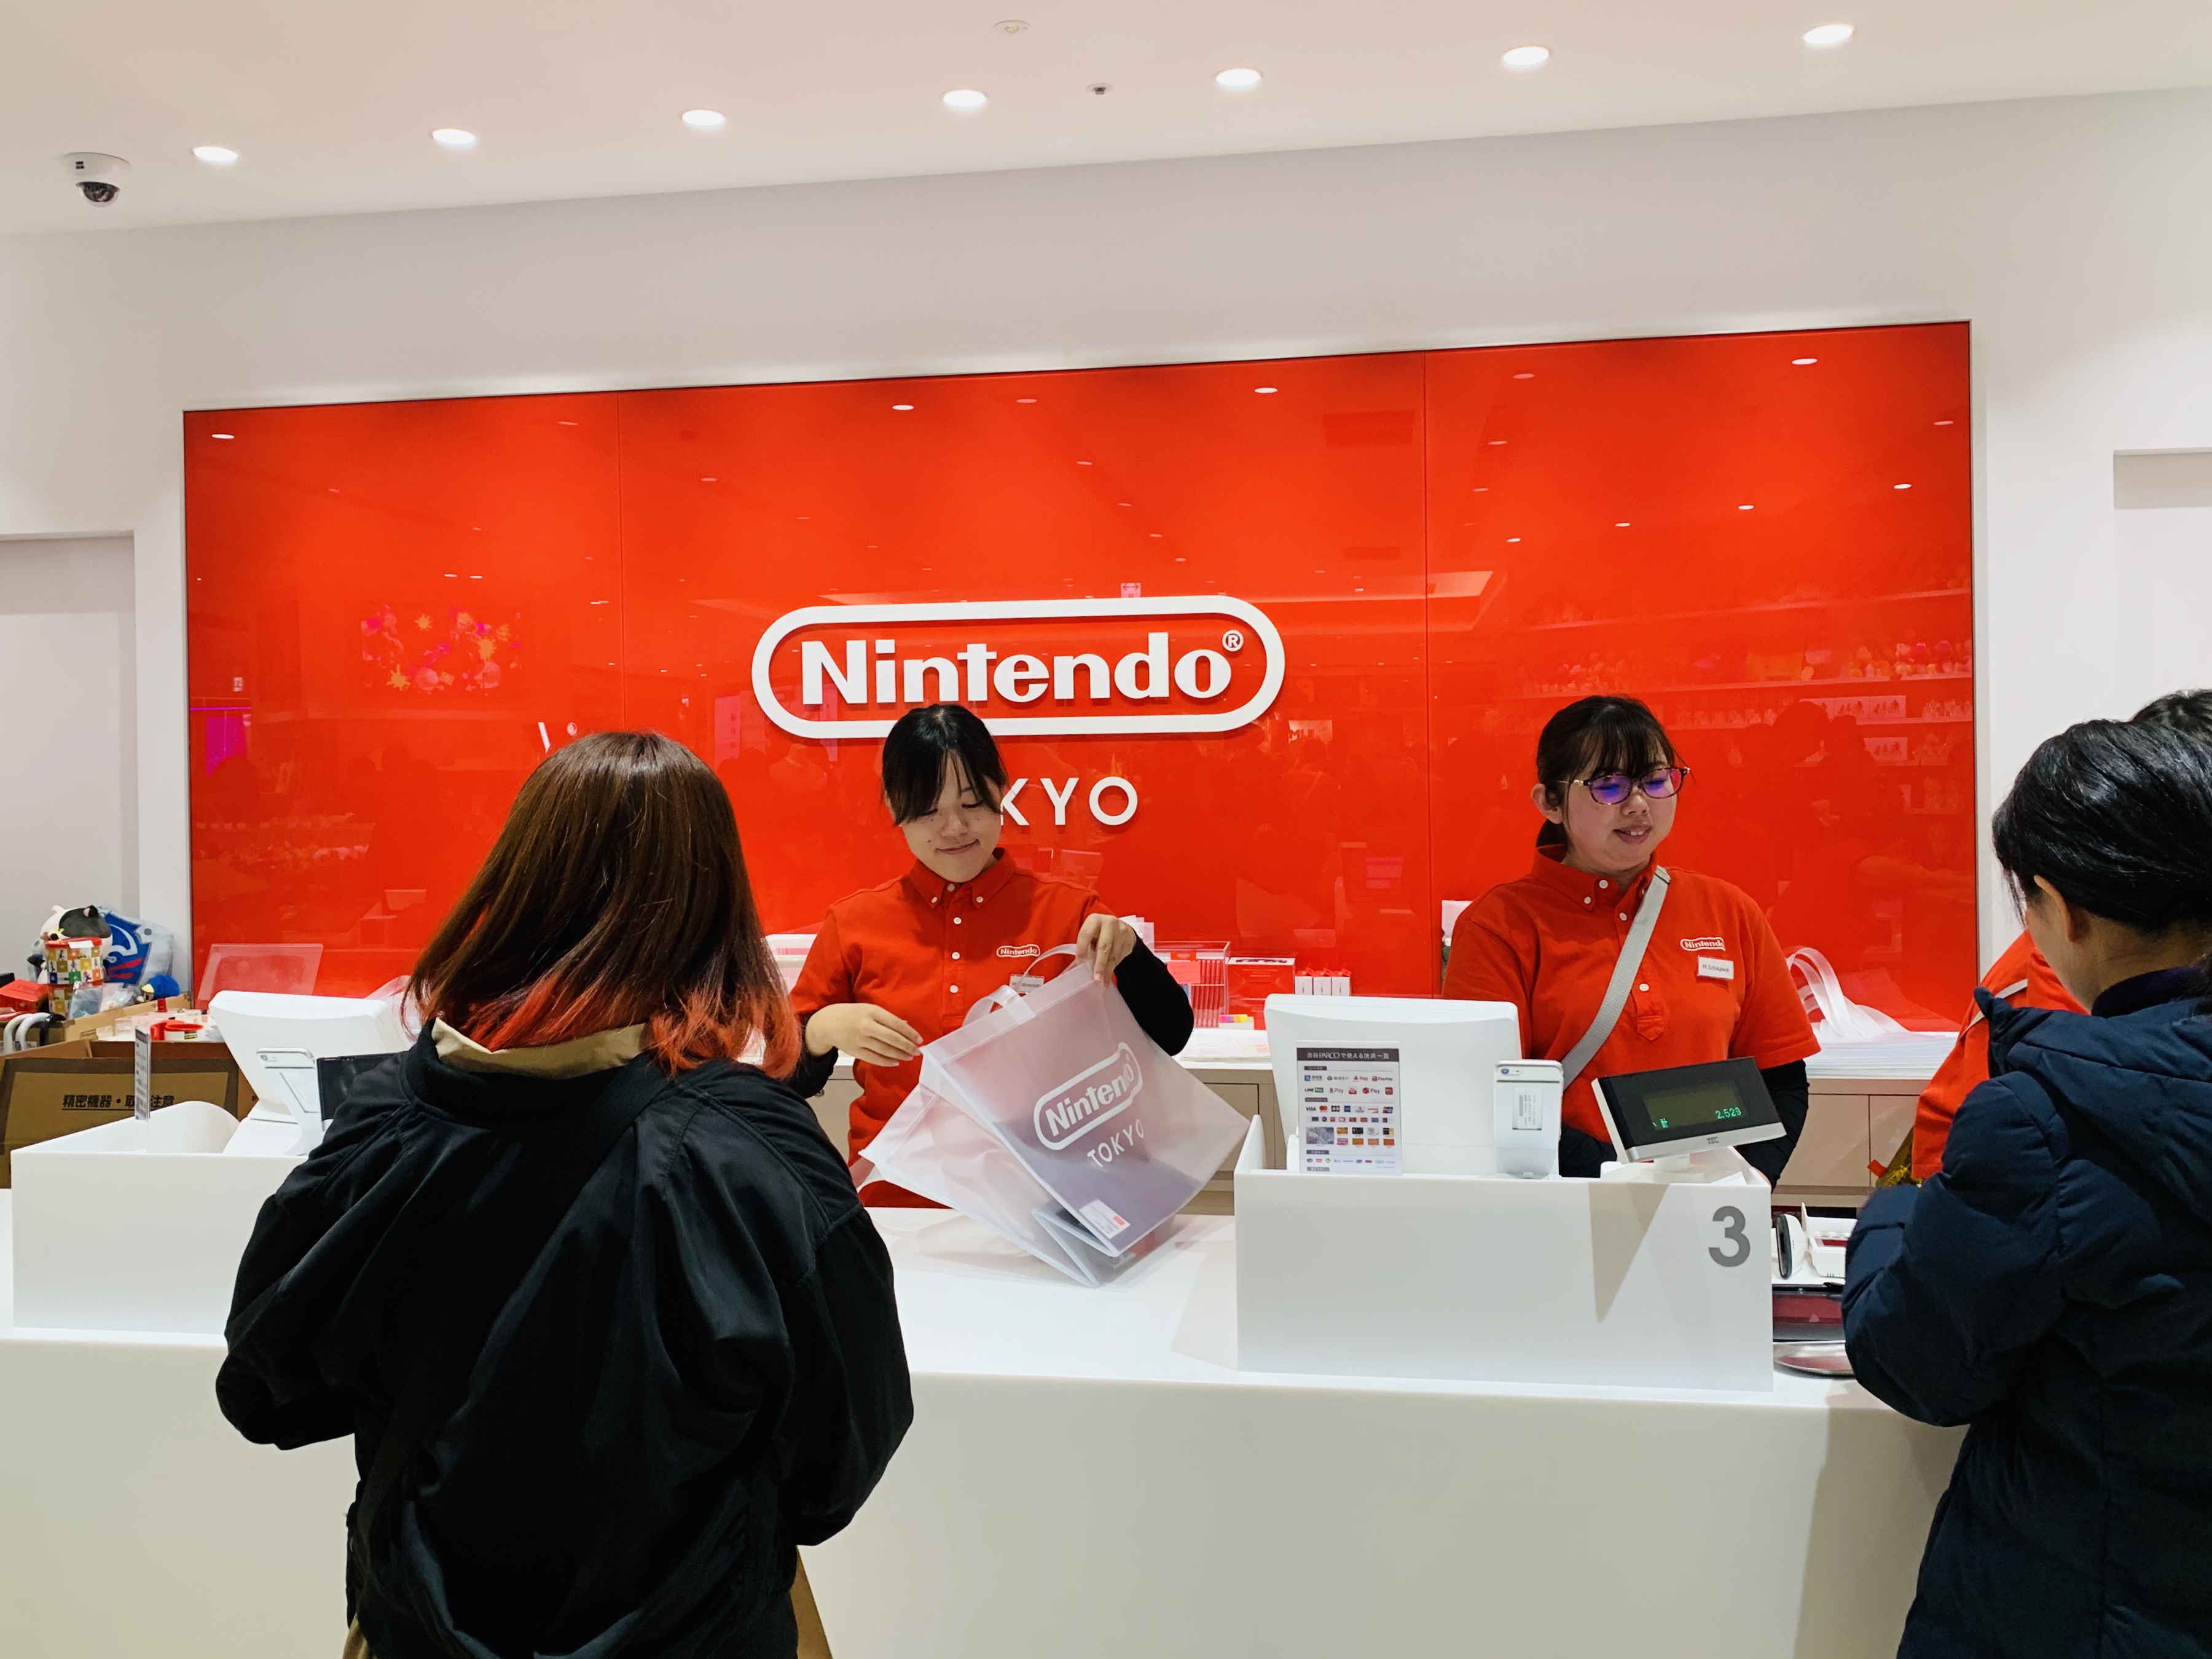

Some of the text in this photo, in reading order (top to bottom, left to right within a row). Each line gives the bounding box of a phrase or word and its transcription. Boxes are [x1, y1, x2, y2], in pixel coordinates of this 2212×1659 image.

[1000, 776, 1138, 825] KYO
[1000, 946, 1038, 955] Nintendo
[62, 1094, 175, 1108] 精密機器・取注意
[1086, 1119, 1144, 1167] TOKYO
[1708, 1206, 1751, 1267] 3
